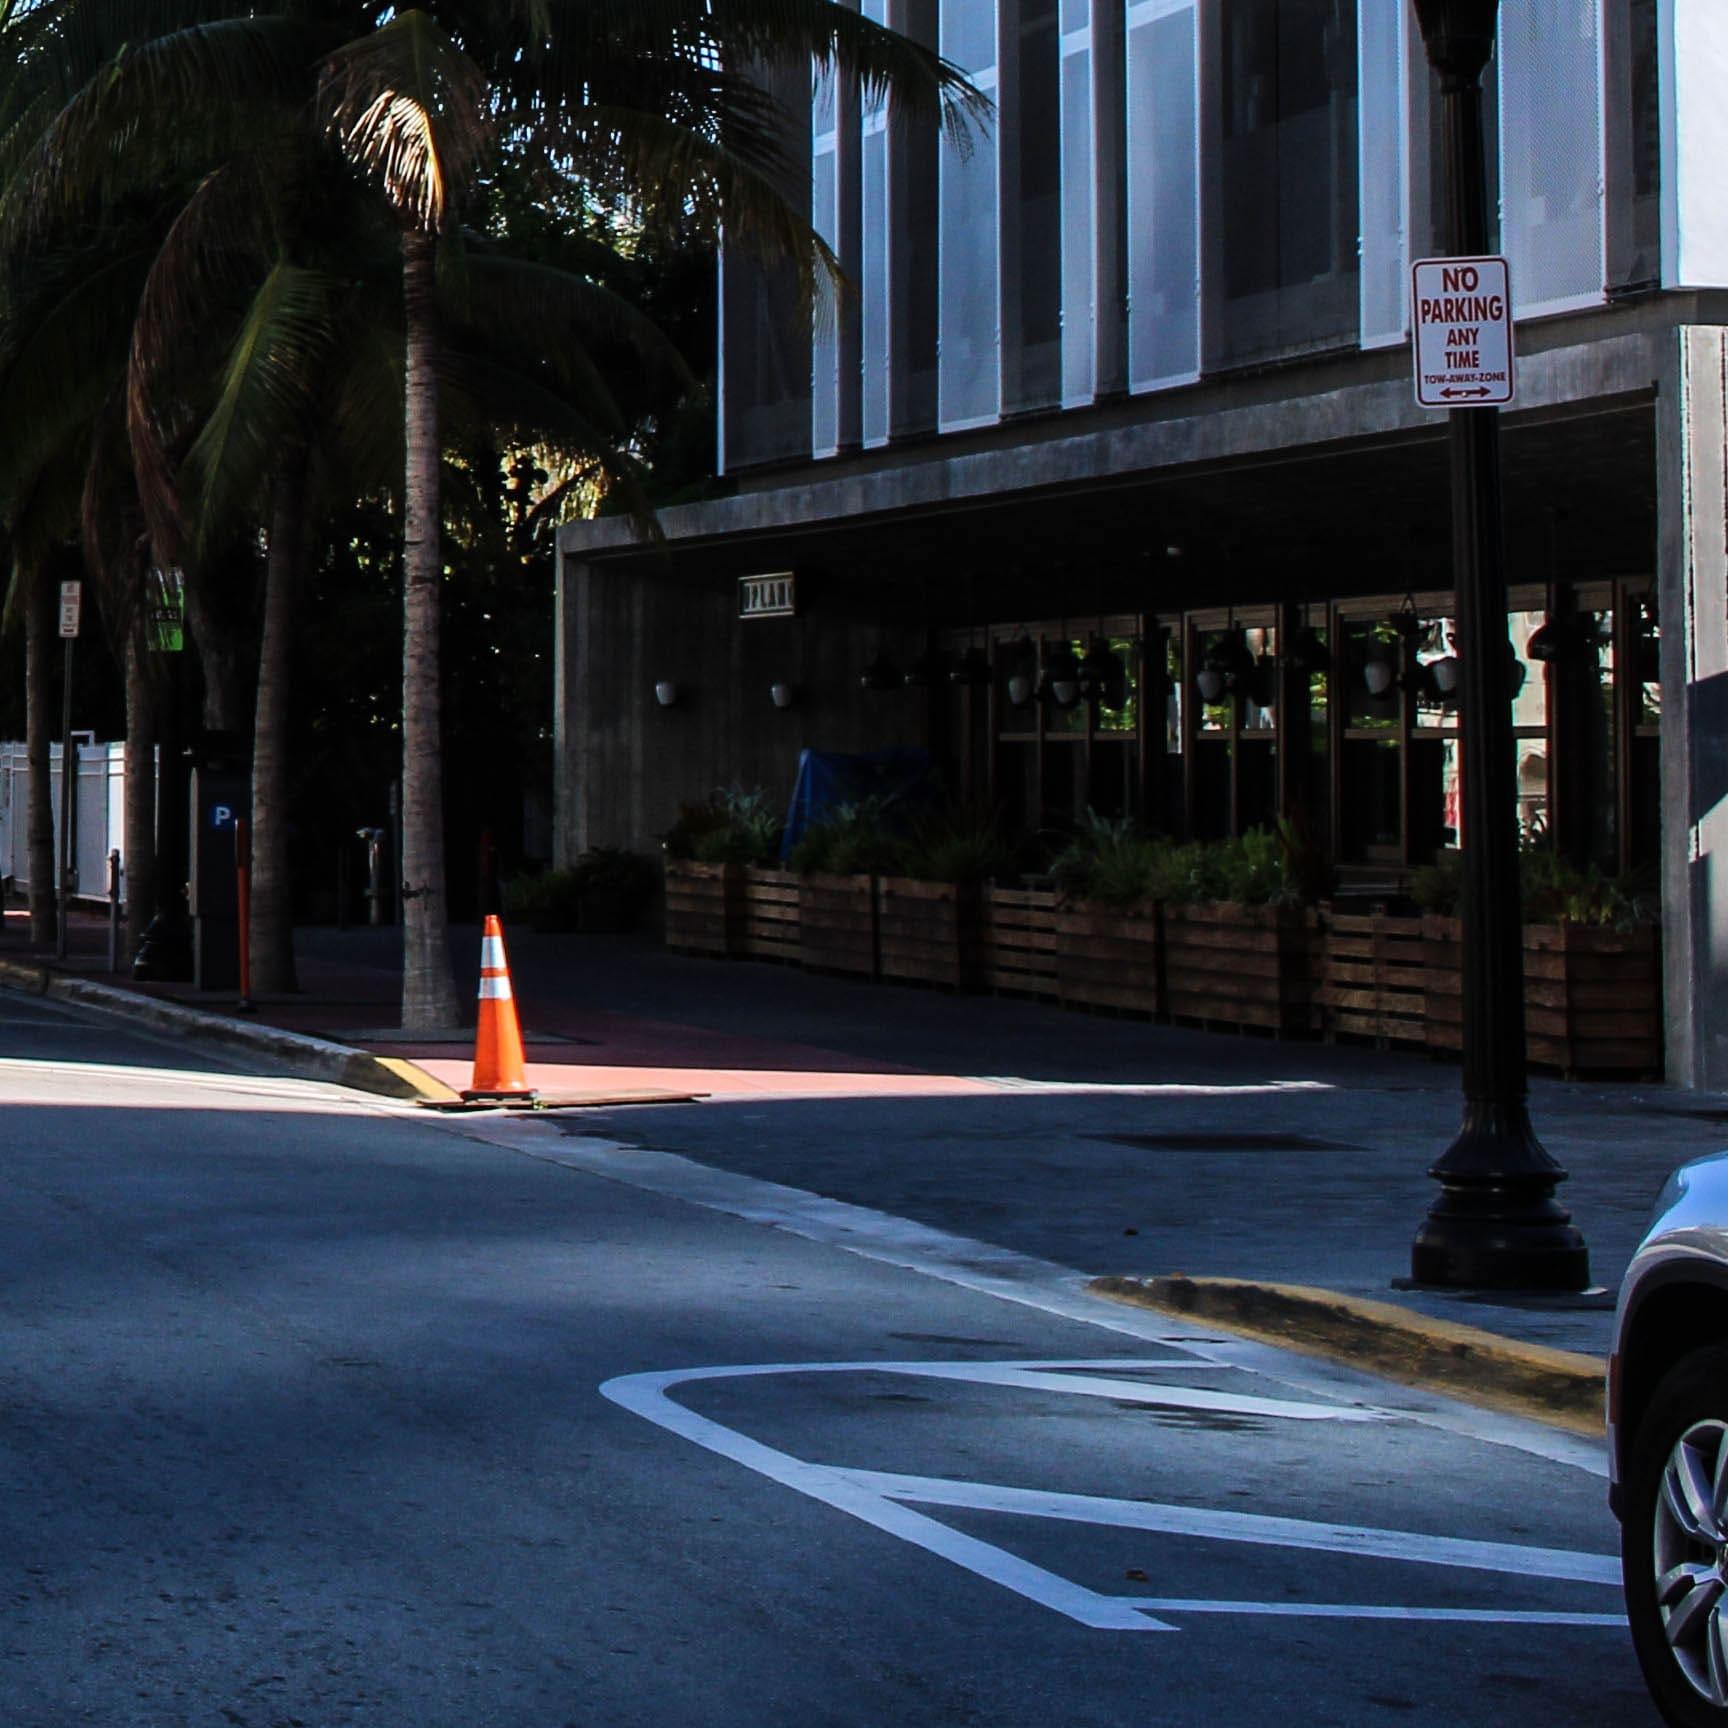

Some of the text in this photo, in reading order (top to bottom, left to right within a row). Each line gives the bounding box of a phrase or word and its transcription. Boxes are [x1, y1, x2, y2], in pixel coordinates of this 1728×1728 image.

[1443, 267, 1479, 292] NO
[1421, 296, 1503, 323] PARKING
[1447, 328, 1479, 347] ANY
[1445, 351, 1479, 369] TIME
[1424, 372, 1506, 384] TOW-AWAY-ZONE
[215, 806, 231, 826] P
